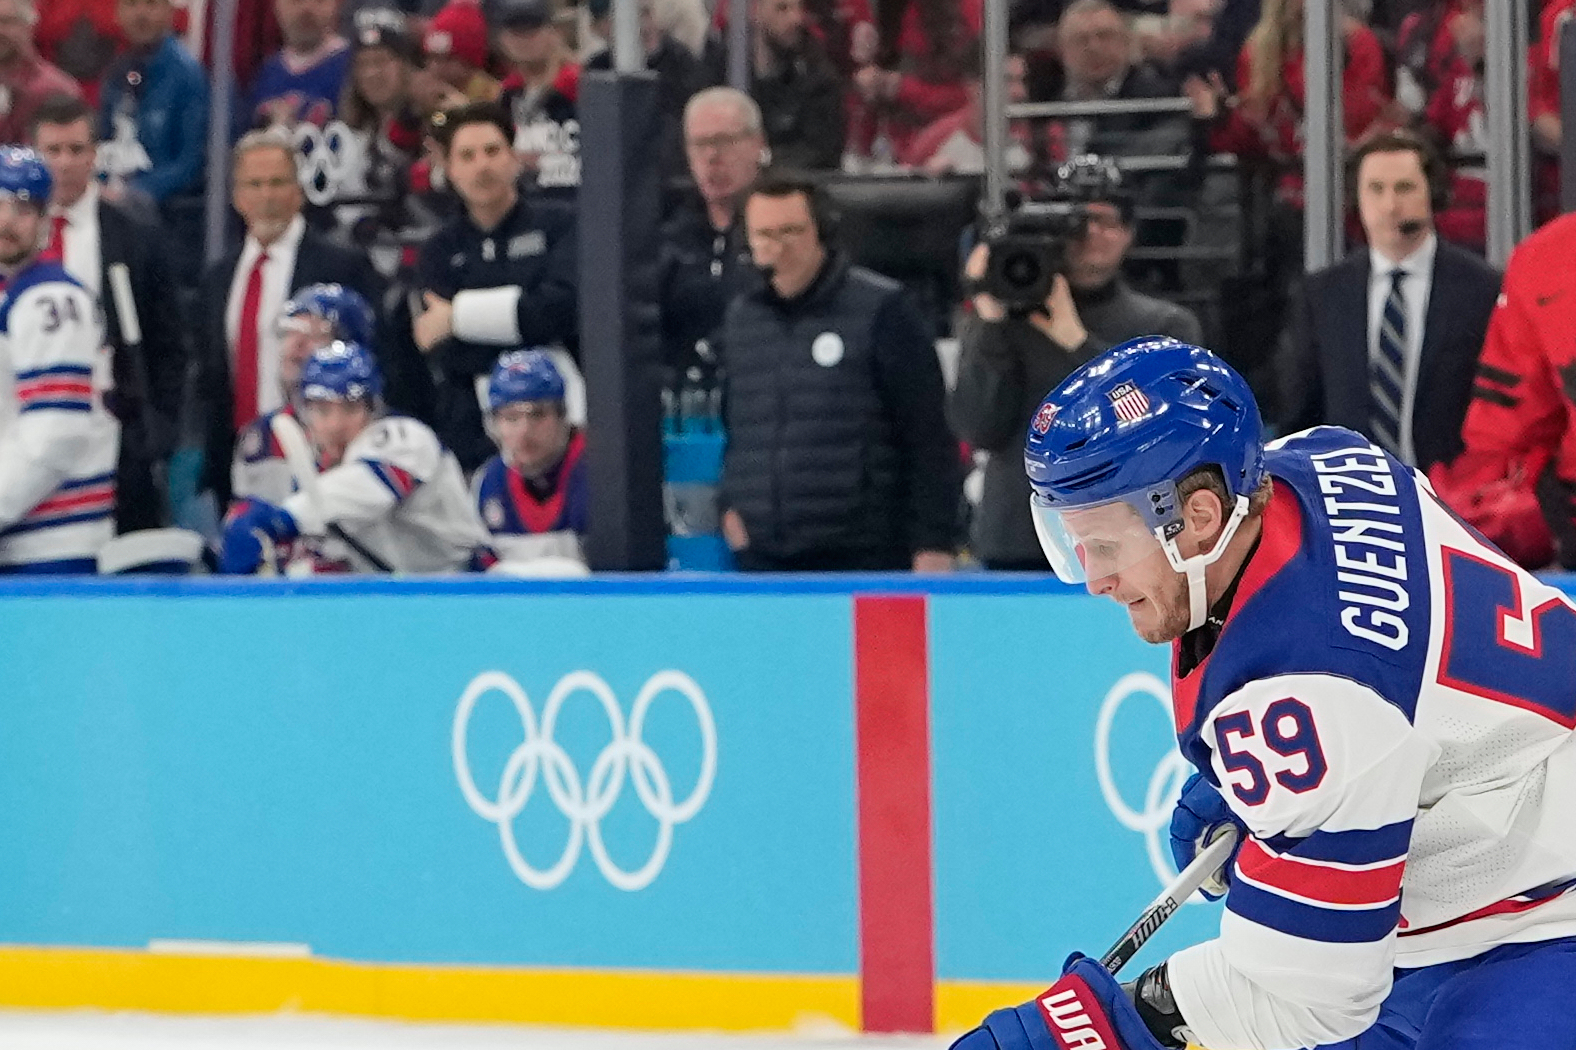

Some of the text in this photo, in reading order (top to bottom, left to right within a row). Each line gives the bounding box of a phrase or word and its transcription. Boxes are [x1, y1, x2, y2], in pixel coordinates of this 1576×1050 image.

[1111, 384, 1134, 400] USA
[1310, 443, 1411, 652] GUENTZEL
[1213, 696, 1328, 807] 59
